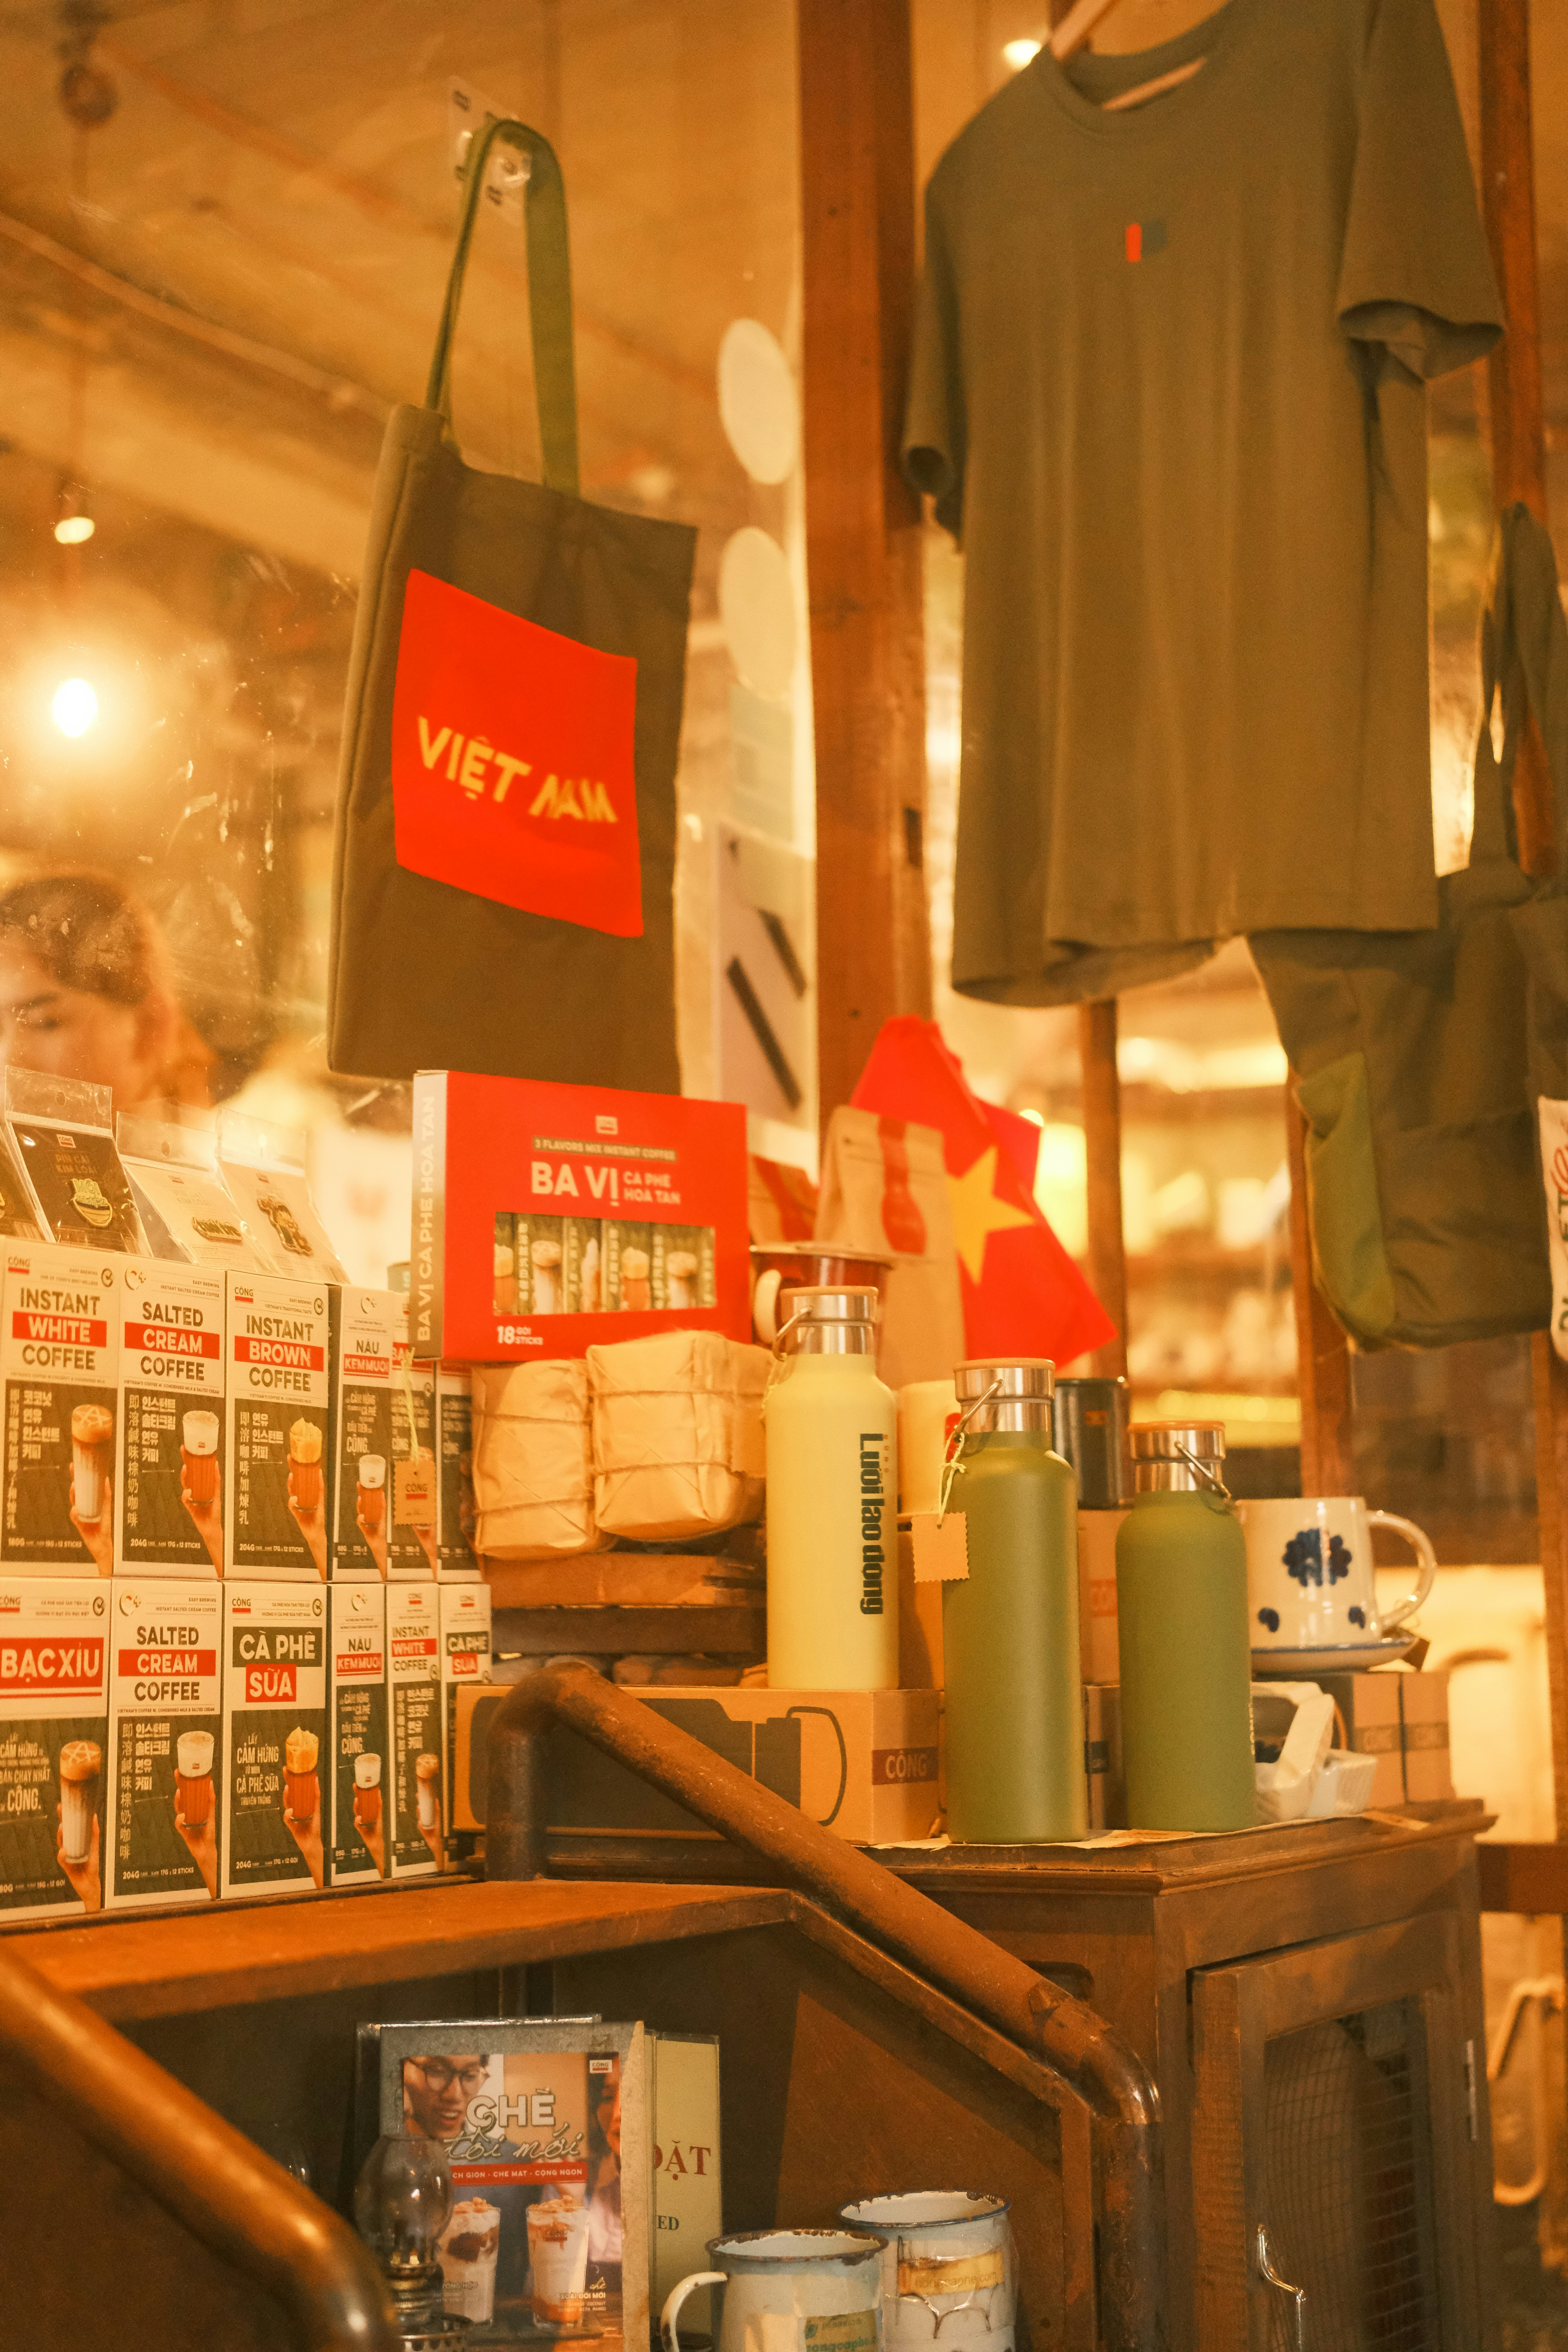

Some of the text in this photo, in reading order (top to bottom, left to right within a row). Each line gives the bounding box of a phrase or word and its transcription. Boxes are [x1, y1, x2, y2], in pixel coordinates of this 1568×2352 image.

[418, 715, 533, 803] VIỆT
[531, 1161, 620, 1207] BA VỊ
[20, 1287, 100, 1315] INSTANT
[142, 1301, 203, 1326] SALTED
[29, 1315, 90, 1343] WHITE
[247, 1315, 314, 1341] INSTANT
[417, 1309, 432, 1341] BA
[497, 1325, 515, 1344] 18
[143, 1328, 202, 1354] CREAM
[249, 1340, 311, 1367] BROWN
[22, 1344, 96, 1370] COFFEE
[140, 1355, 204, 1381] COFFEE
[249, 1367, 311, 1392] COFFEE
[861, 1498, 885, 1540] lao
[130, 1539, 147, 1547] 204G
[136, 1625, 199, 1645] SALTED
[392, 1625, 430, 1638] INSTANT
[239, 1630, 315, 1660] CÀ PHÊ
[393, 1642, 426, 1655] WHITE
[1, 1648, 55, 1683] BẠC
[138, 1654, 198, 1674] CREAM
[393, 1659, 428, 1671] COFFEE
[134, 1681, 200, 1701] COFFEE
[250, 1668, 293, 1697] SỮA
[123, 1871, 139, 1880] 204G
[236, 1860, 251, 1869] 204G
